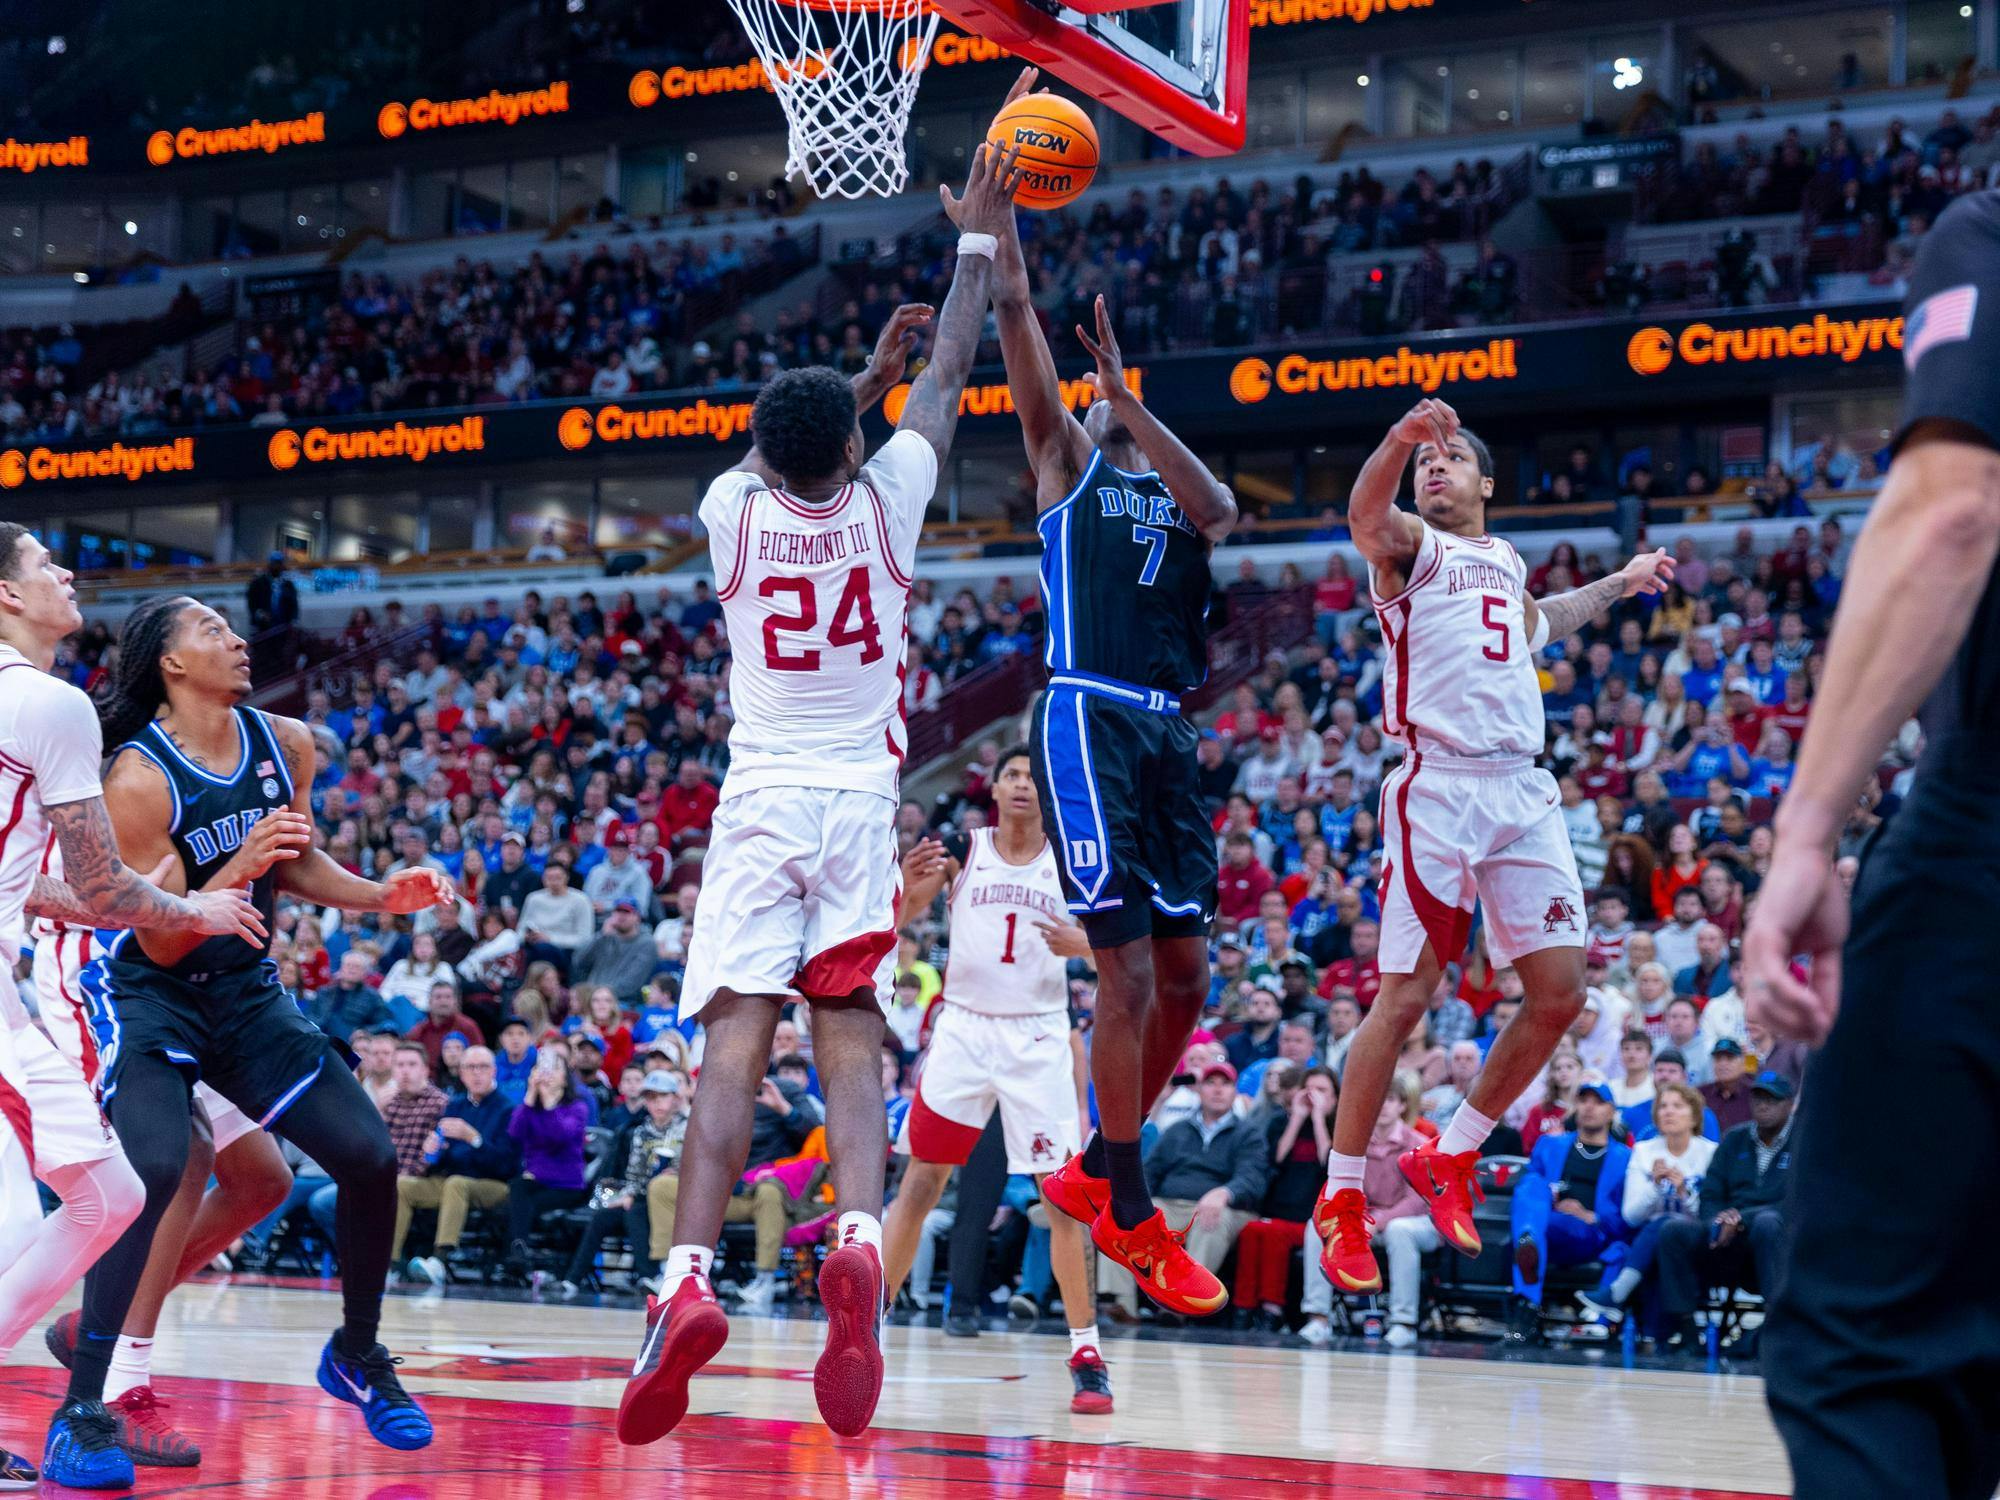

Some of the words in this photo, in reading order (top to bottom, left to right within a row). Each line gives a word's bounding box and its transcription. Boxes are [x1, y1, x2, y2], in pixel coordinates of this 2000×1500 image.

[408, 81, 569, 130] Crunchyroll
[175, 112, 326, 154] Crunchyroll
[1015, 128, 1071, 155] NCAA
[1008, 167, 1072, 192] Wils
[1276, 339, 1518, 393] Crunchyroll
[302, 416, 485, 462] Crunchyroll
[596, 399, 758, 441] Crunchyr
[28, 437, 195, 481] Crunchyroll
[758, 530, 847, 565] RICHMOND
[848, 522, 871, 554] III
[1132, 524, 1168, 586] 7
[759, 566, 884, 671] 24
[1482, 594, 1510, 662] 5
[1148, 690, 1165, 711] D
[184, 807, 278, 865] DUK
[1070, 839, 1098, 867] D
[970, 884, 1056, 915] RAZORBACKS
[1001, 912, 1017, 964] 1
